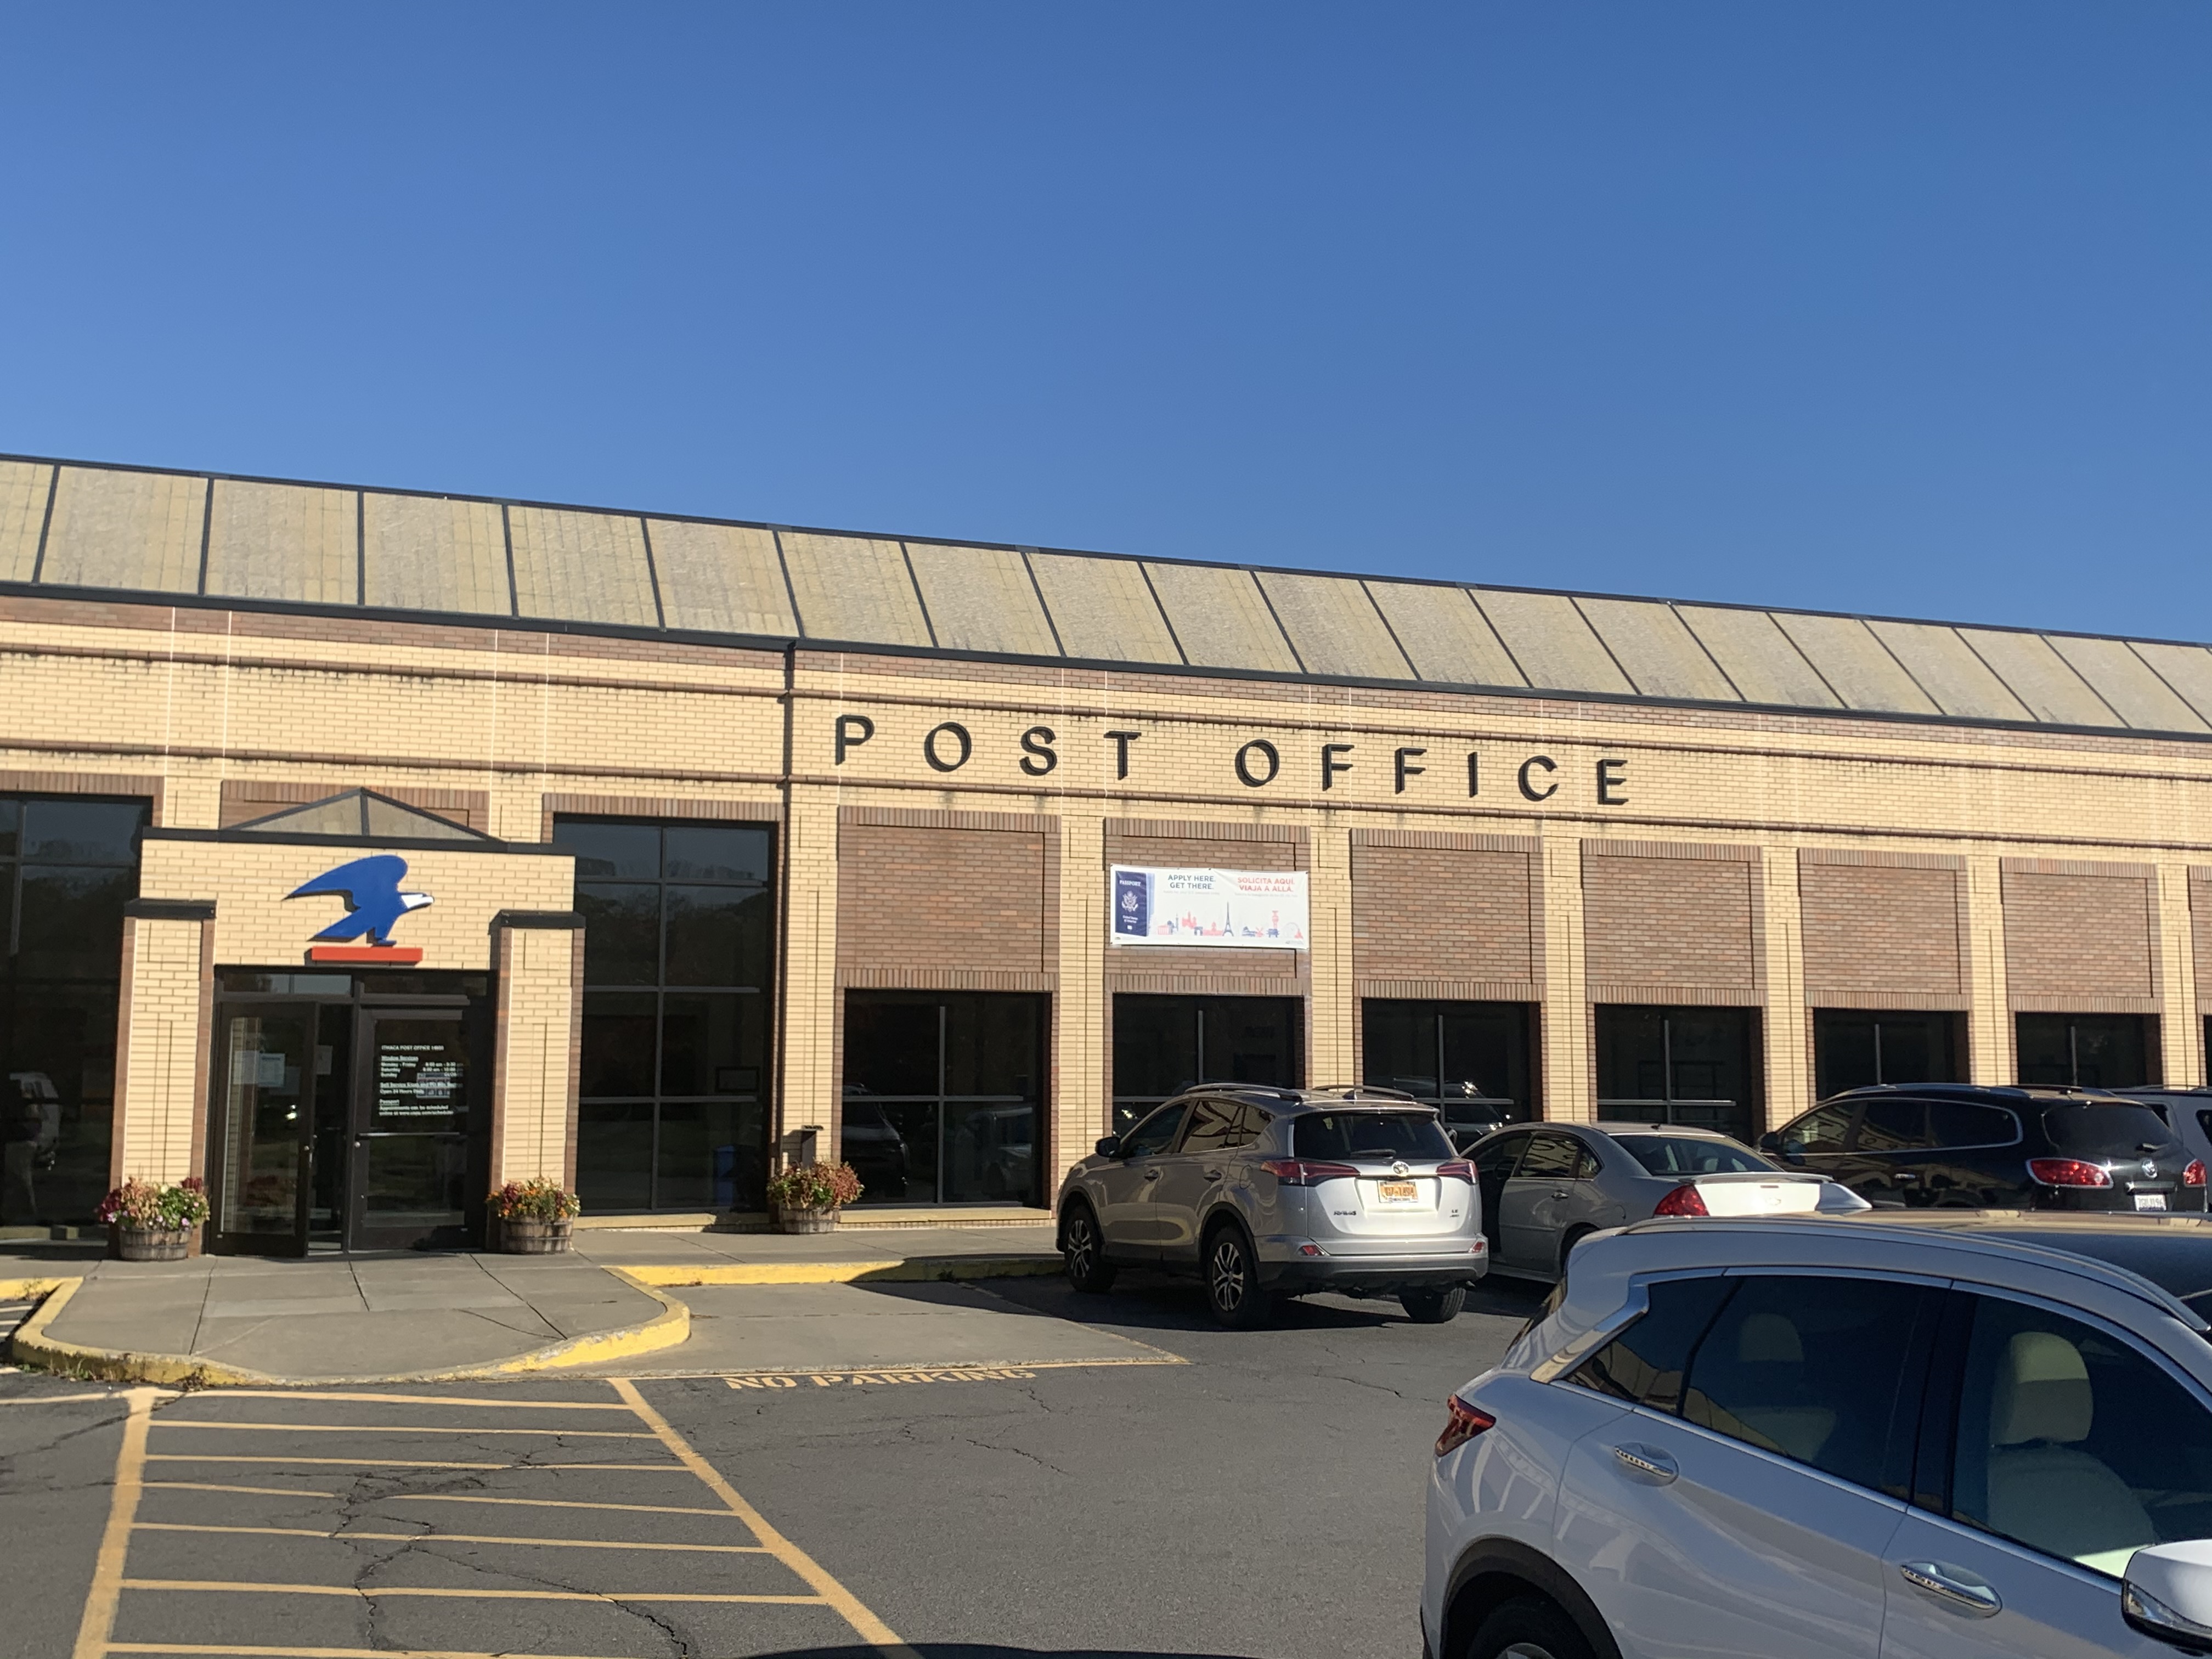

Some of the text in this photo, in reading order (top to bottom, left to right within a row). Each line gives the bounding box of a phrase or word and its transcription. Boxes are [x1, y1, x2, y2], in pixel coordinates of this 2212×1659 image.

[834, 713, 1629, 805] POST OFFICE
[724, 1368, 1037, 1390] NO PARKING
